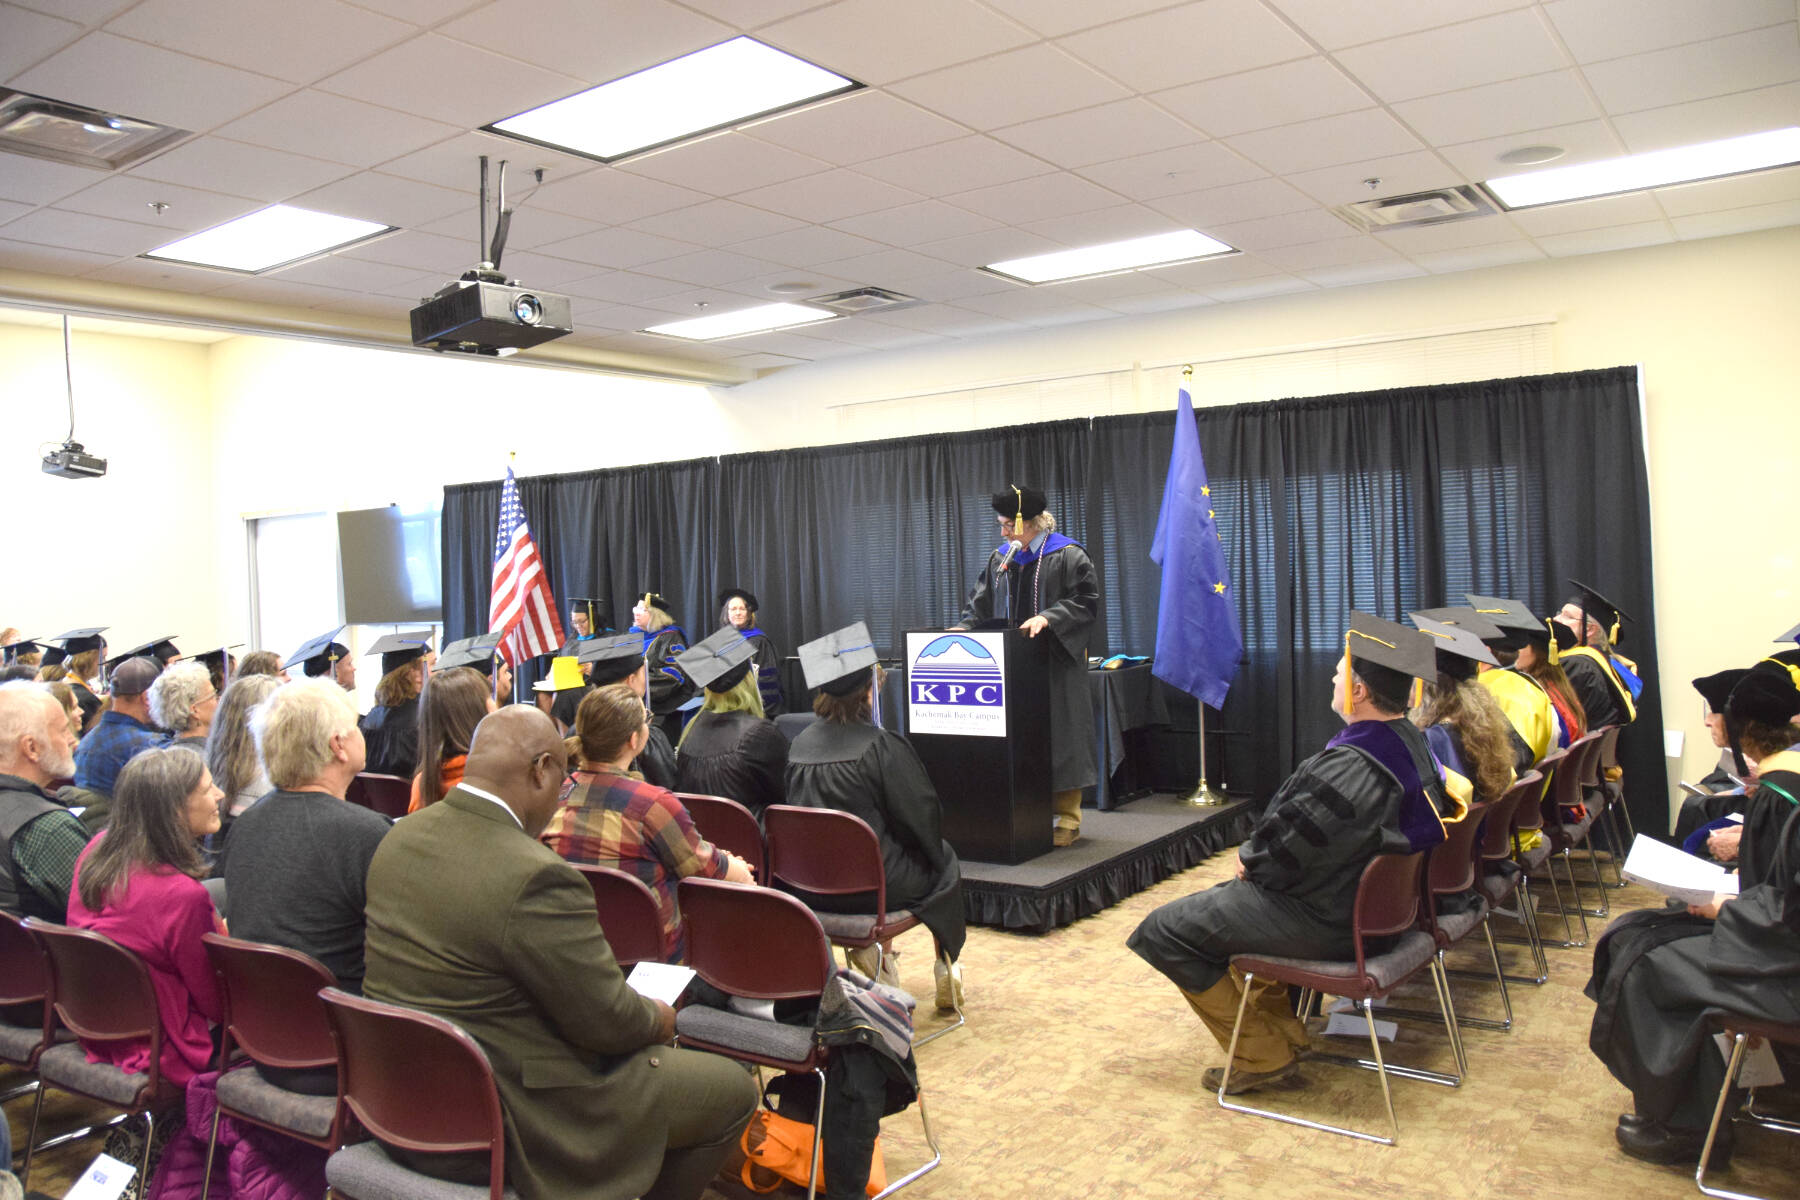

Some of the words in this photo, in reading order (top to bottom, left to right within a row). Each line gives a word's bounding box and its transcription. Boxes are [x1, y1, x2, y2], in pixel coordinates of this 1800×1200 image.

[916, 684, 997, 704] KPC
[915, 709, 951, 719] Kachemak
[954, 711, 967, 720] Bay
[969, 711, 1000, 721] Campus
